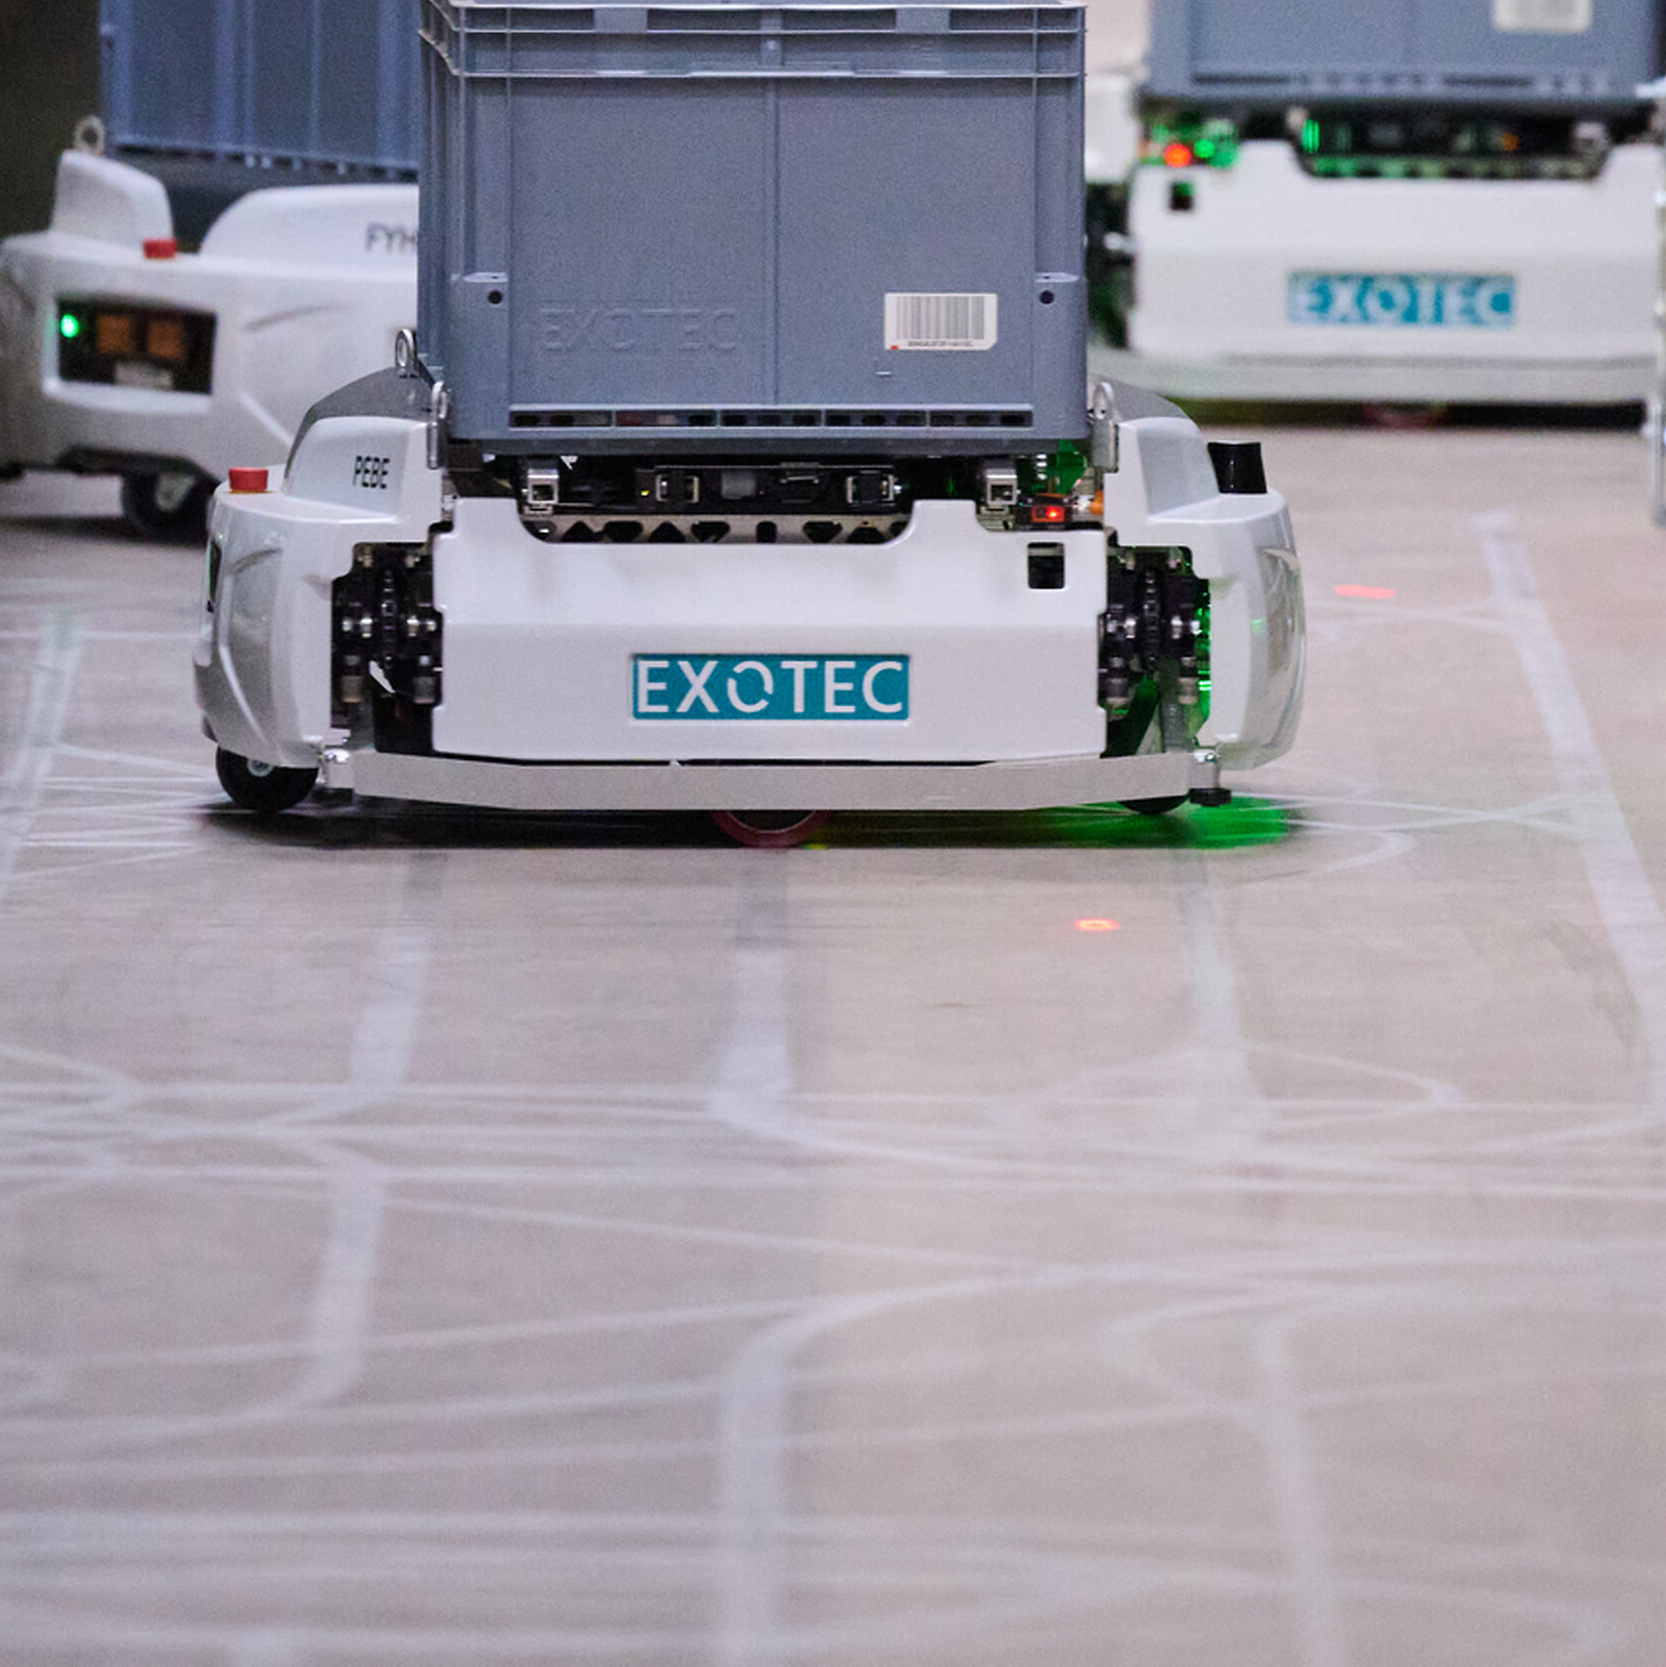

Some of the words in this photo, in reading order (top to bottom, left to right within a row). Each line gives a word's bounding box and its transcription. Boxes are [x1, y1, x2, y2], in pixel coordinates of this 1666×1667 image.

[1291, 278, 1510, 320] EXOTEC
[353, 455, 390, 489] PEBE
[637, 660, 903, 713] EXOTEC
